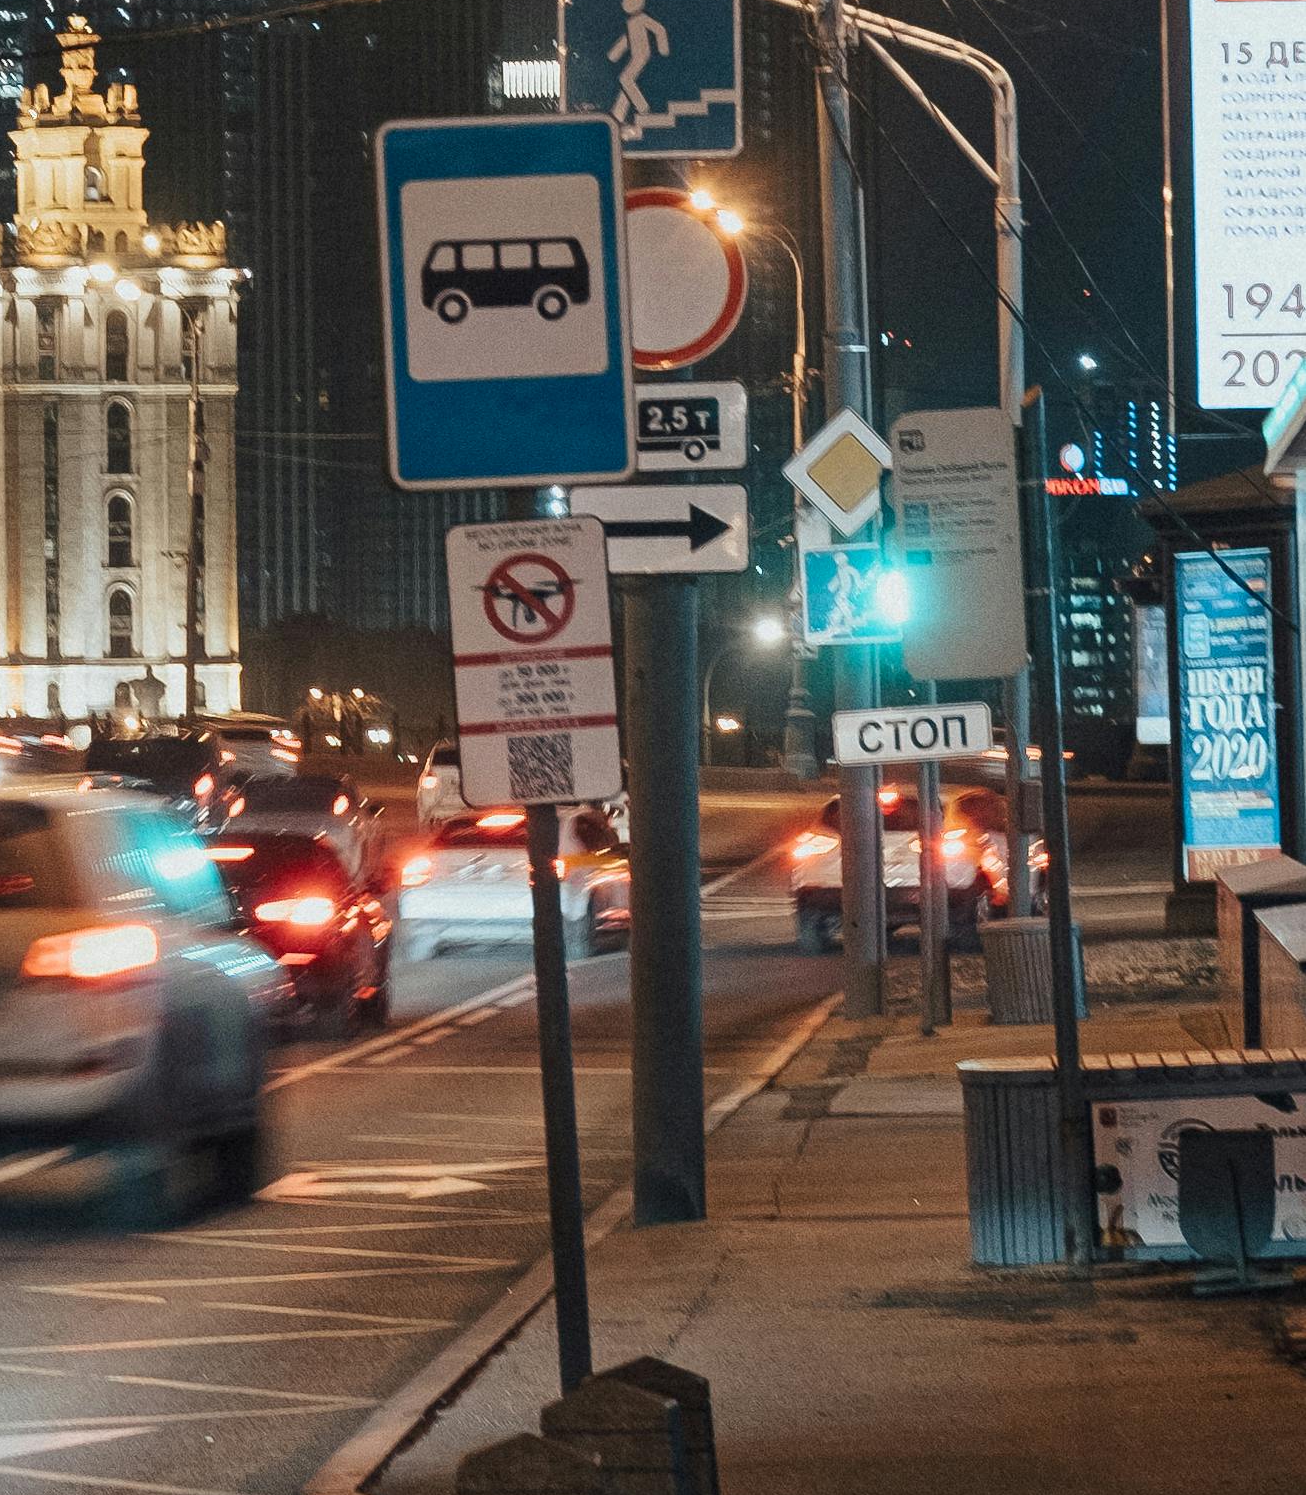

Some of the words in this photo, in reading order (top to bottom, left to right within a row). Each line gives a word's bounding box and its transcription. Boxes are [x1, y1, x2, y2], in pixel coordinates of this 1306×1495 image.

[1221, 42, 1252, 64] 15
[1266, 41, 1306, 68] ДЕ
[647, 406, 688, 433] 2,5
[1188, 666, 1266, 695] ПЕСНЯ
[1188, 694, 1267, 733] ГОДА
[858, 713, 968, 753] СТОП
[1190, 732, 1268, 781] 2020
